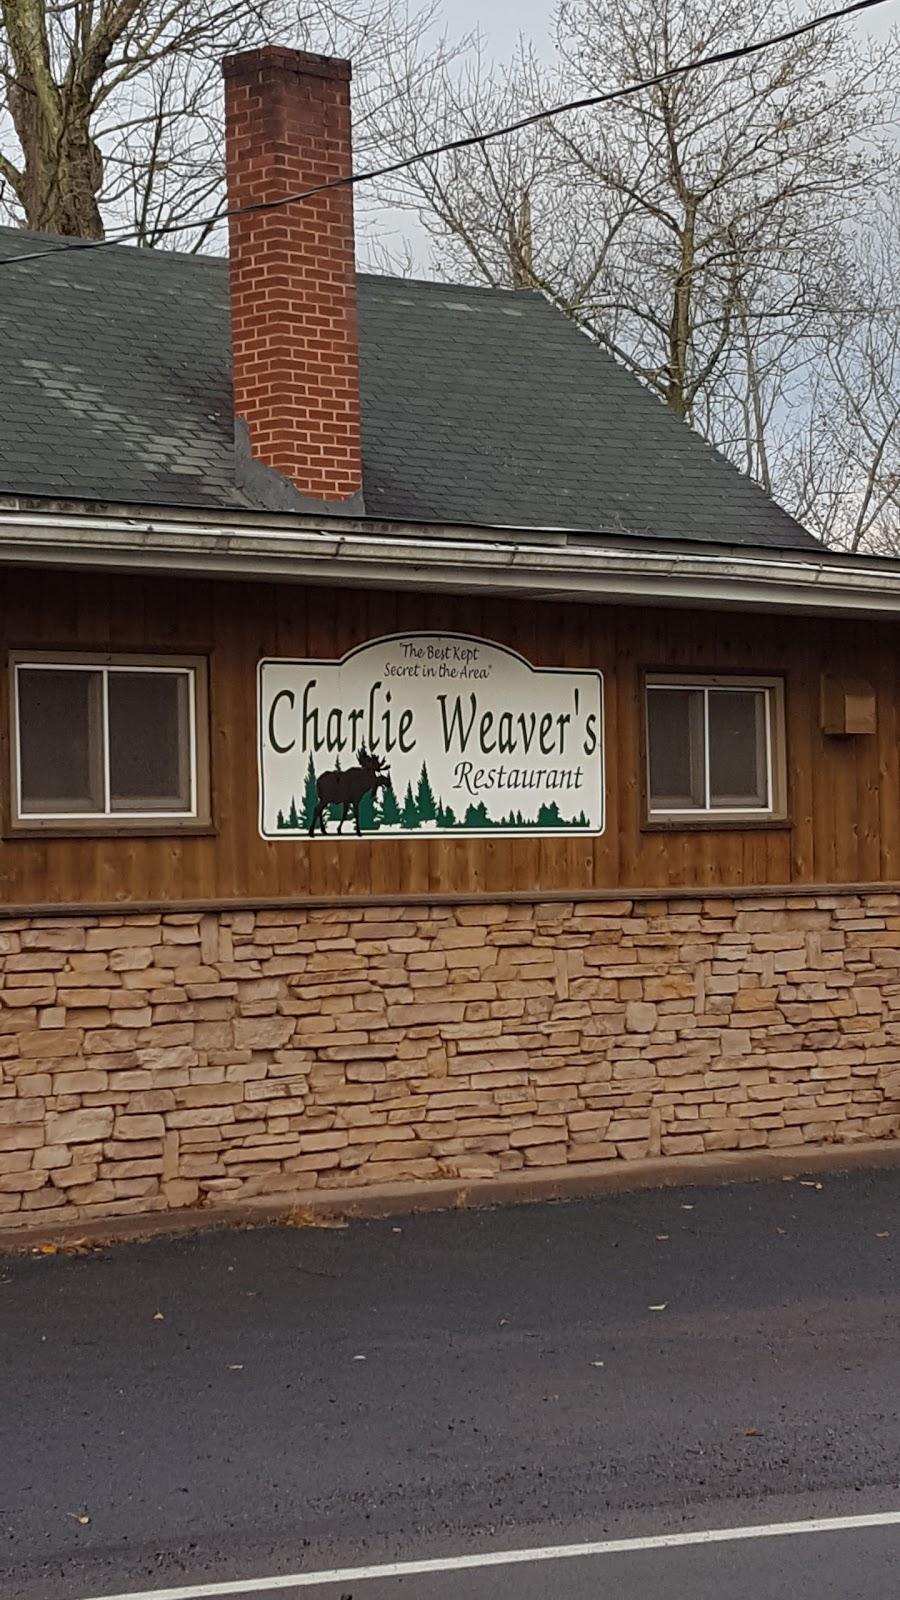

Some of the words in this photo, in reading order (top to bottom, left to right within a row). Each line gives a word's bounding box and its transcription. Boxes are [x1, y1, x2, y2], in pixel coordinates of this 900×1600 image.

[427, 645, 451, 661] Best
[453, 646, 479, 664] Kept
[384, 662, 421, 677] Secret
[423, 664, 437, 677] in
[438, 663, 459, 678] the
[268, 680, 416, 753] Charlie
[437, 688, 597, 756] Weaver's
[452, 761, 583, 795] Restaurant
